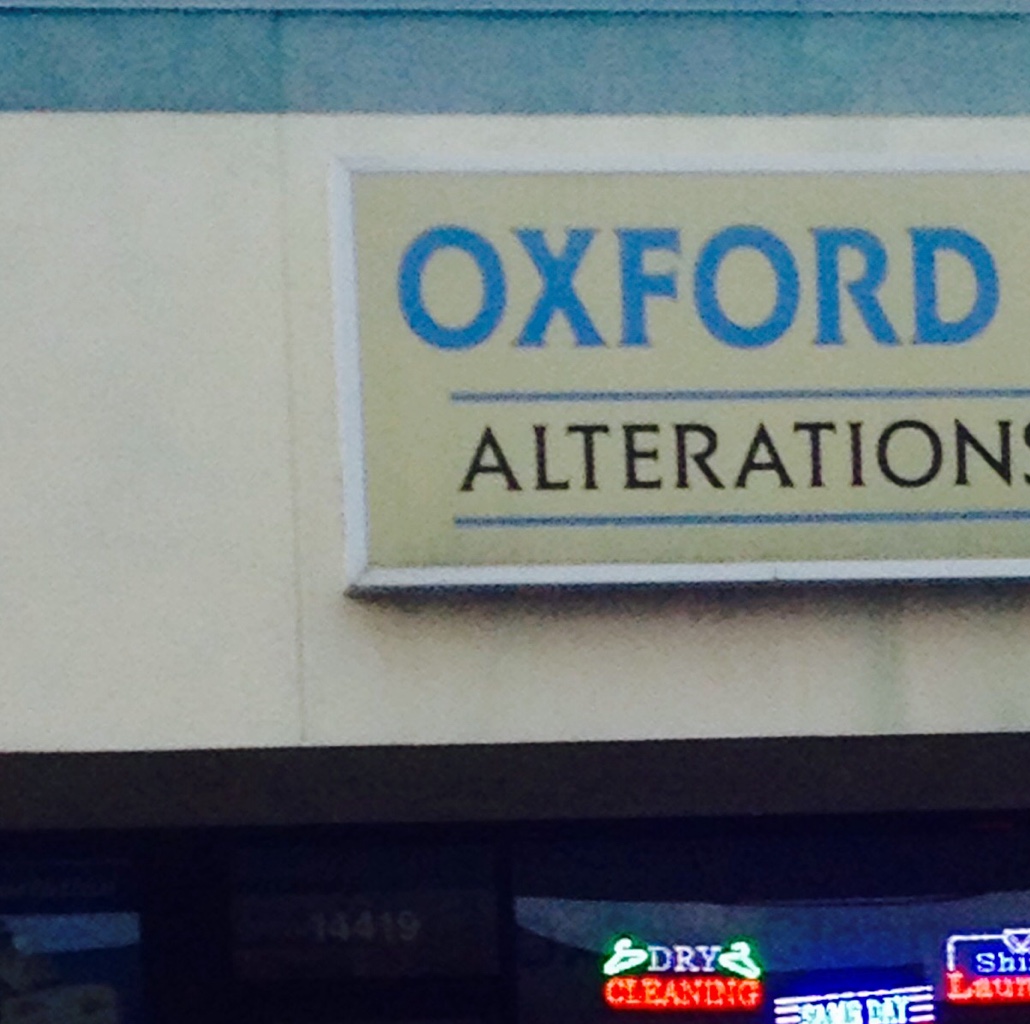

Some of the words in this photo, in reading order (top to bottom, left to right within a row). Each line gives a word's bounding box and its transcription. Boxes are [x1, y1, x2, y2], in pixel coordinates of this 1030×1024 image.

[398, 224, 999, 350] OXFORD
[648, 945, 722, 972] DRY
[605, 977, 761, 1007] CLEANING
